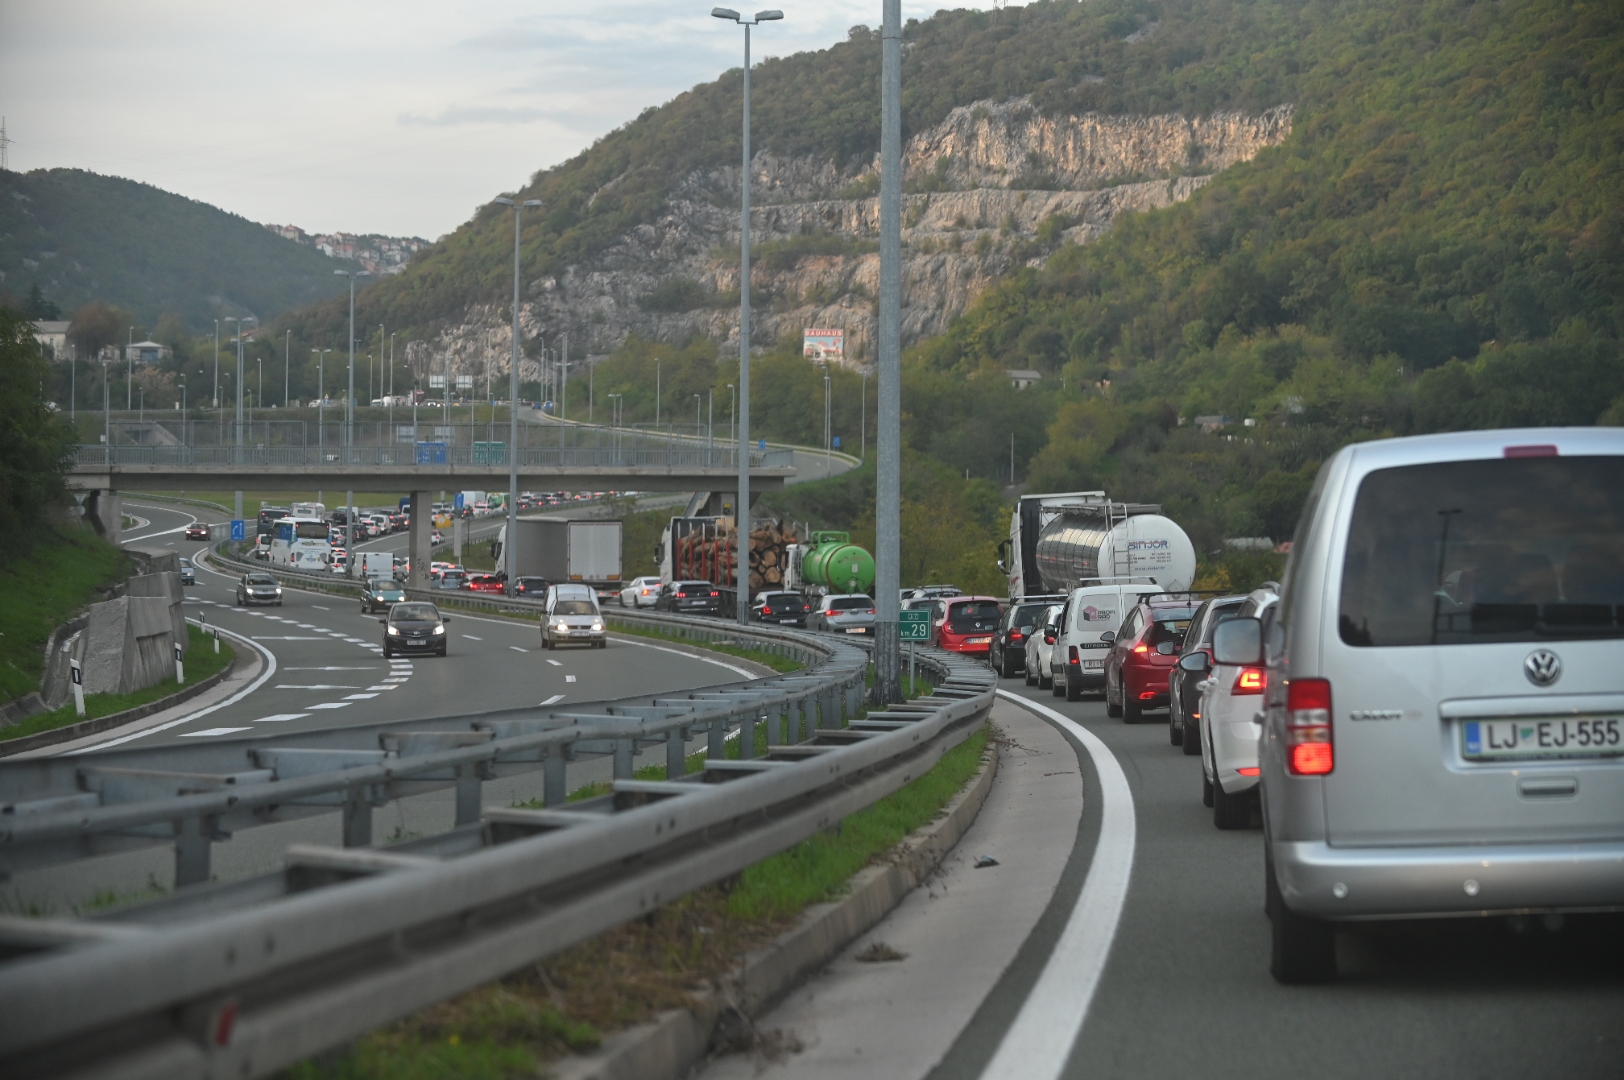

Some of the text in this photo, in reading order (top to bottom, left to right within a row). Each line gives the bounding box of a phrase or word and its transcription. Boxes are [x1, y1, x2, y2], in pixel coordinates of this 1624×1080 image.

[1128, 540, 1168, 549] SINJOR
[911, 623, 926, 636] 29
[1487, 720, 1620, 749] LJ EJ-555
